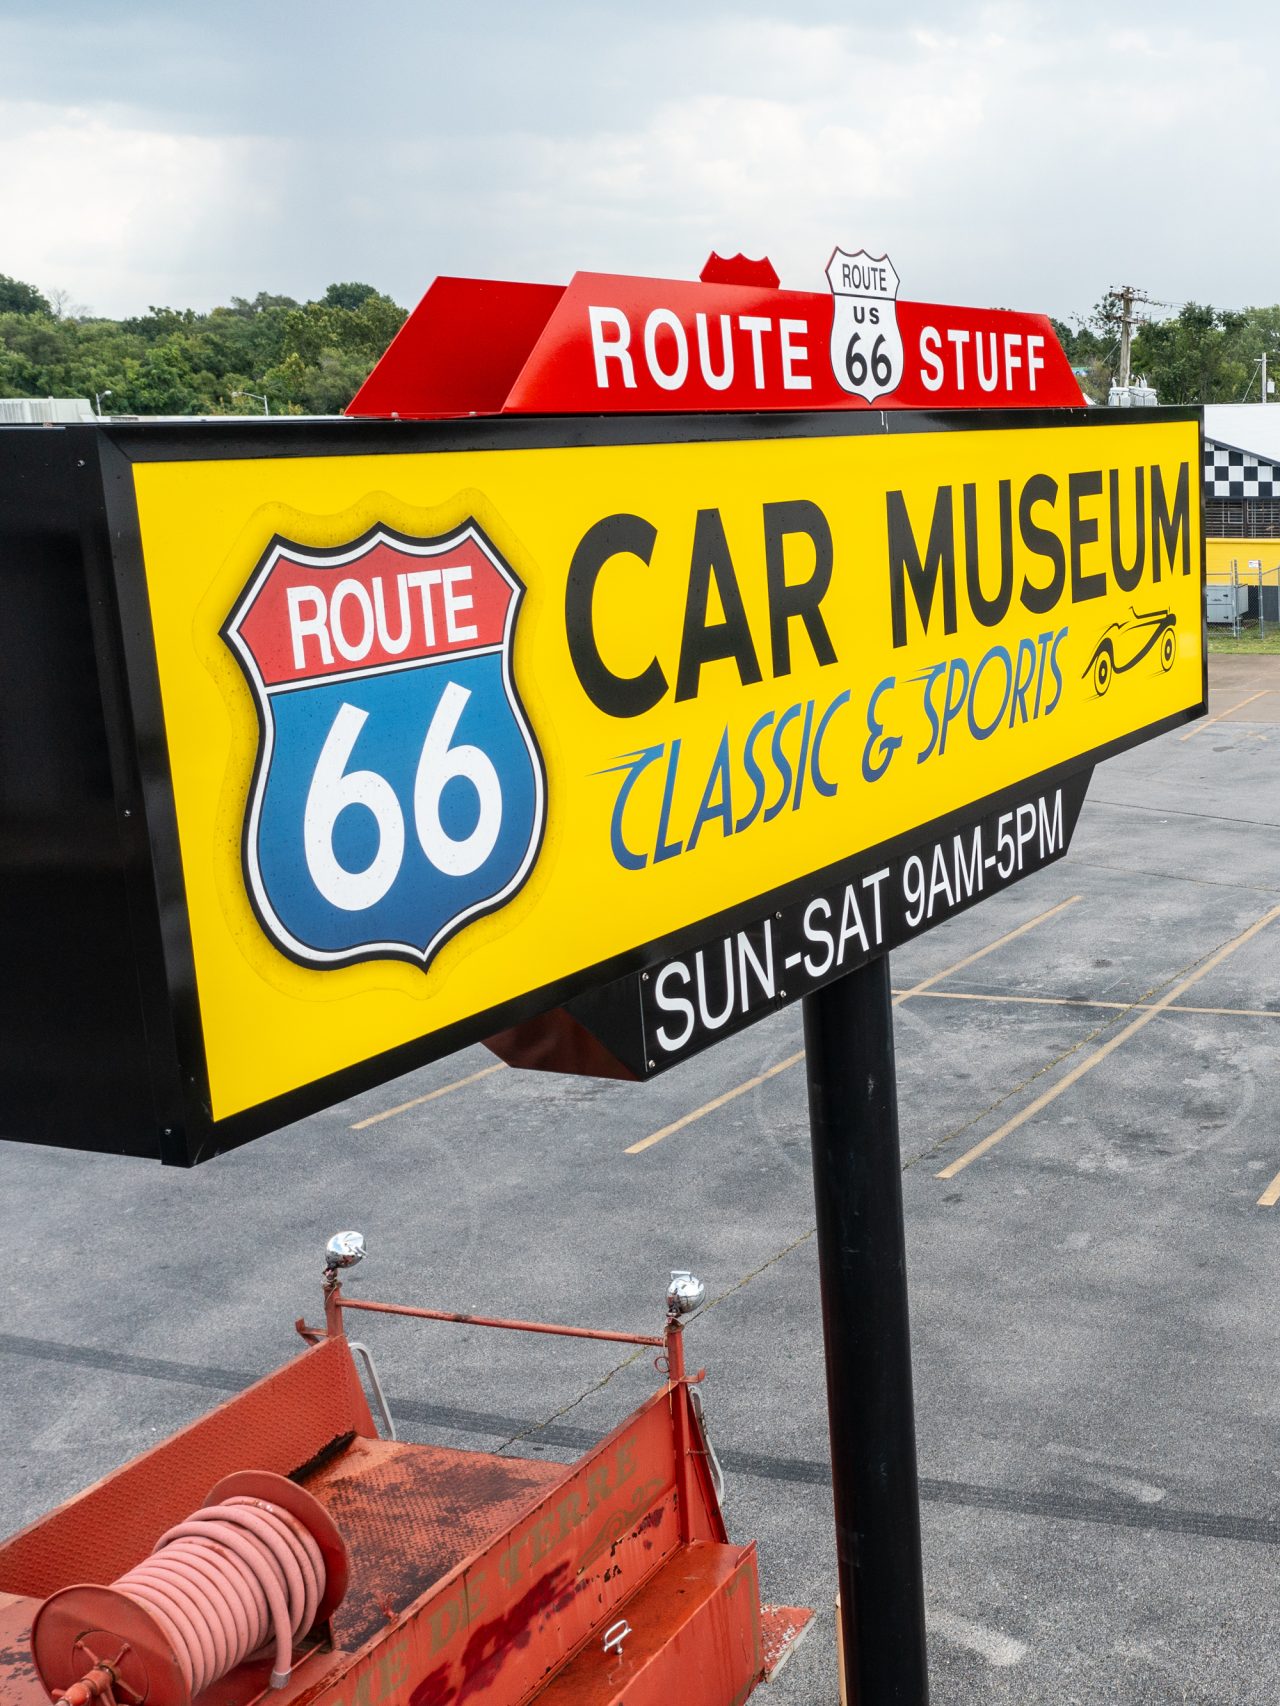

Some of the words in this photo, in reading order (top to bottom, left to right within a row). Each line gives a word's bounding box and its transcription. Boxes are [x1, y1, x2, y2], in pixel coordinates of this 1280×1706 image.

[841, 262, 888, 293] ROUTE
[853, 305, 880, 325] US
[588, 305, 813, 391] ROUTE
[919, 326, 1045, 392] STUFF
[845, 331, 892, 387] 66
[286, 565, 478, 670] ROUTE
[565, 499, 838, 719] CAR
[885, 461, 1192, 649] MUSEUM
[303, 680, 502, 912] 66
[588, 689, 851, 871] CLASSIC
[861, 675, 903, 783] &
[901, 626, 1069, 765] SPORTS
[902, 788, 1064, 928] 9AM-5PM
[429, 1571, 489, 1660] DE
[499, 1434, 637, 1590] TERRE
